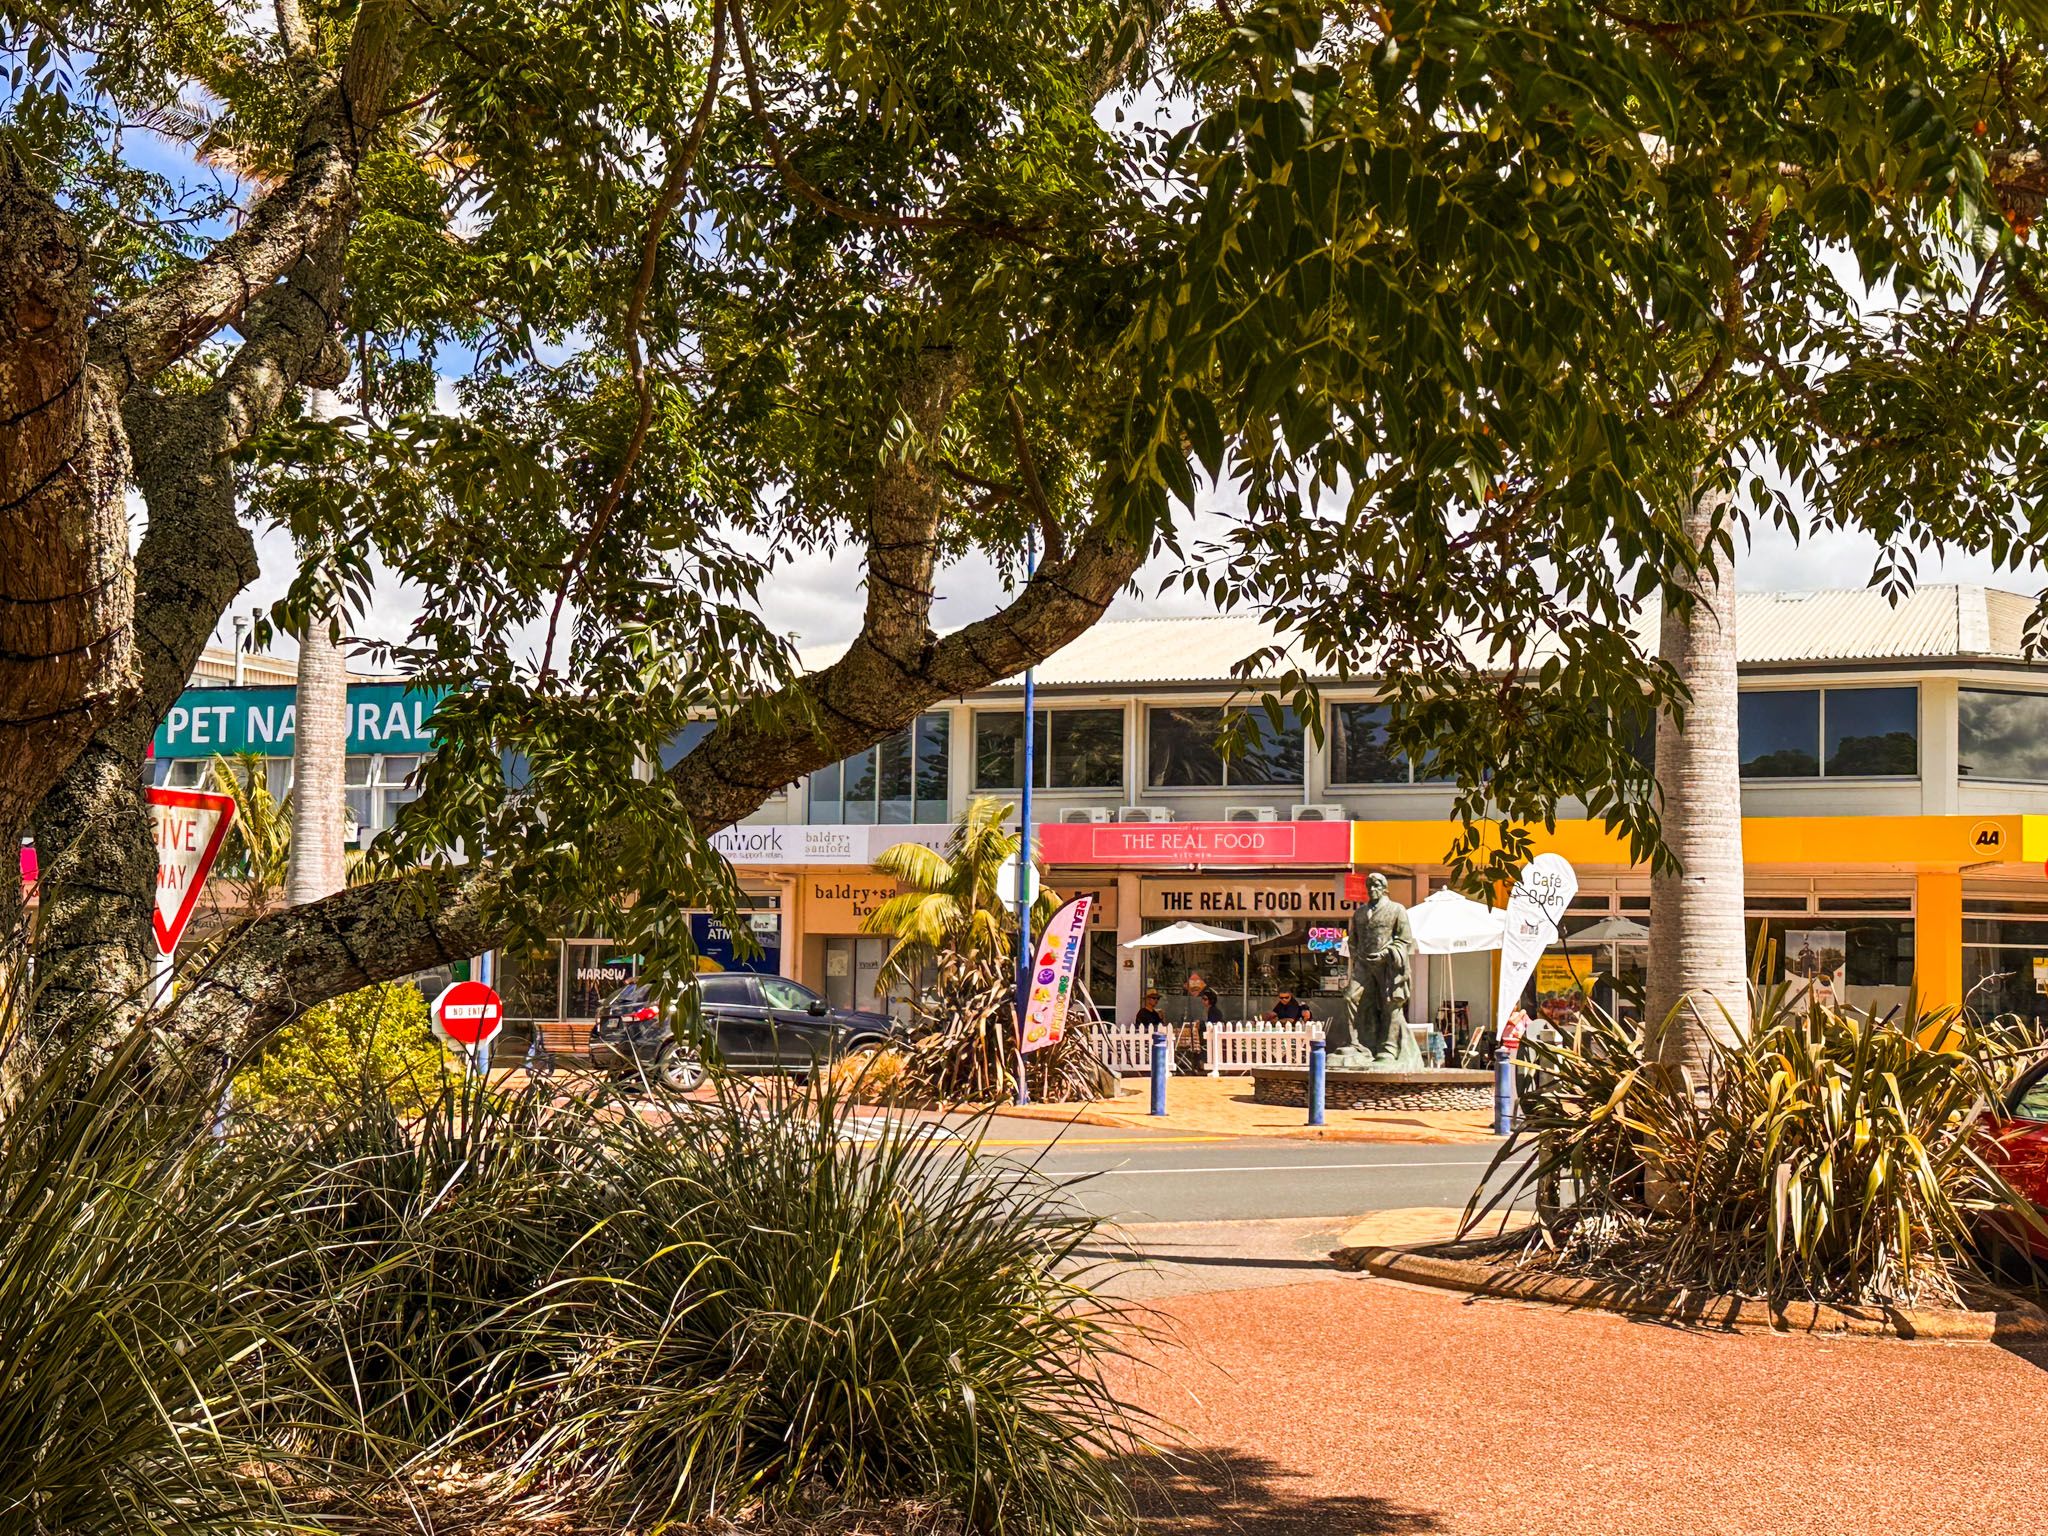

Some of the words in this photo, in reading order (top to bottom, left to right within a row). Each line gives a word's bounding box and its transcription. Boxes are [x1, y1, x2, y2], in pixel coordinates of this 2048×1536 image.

[166, 705, 236, 744] PET
[1122, 833, 1155, 849] THE
[1161, 833, 1208, 849] REAL
[1214, 833, 1265, 849] FOOD
[1975, 830, 1999, 846] AA
[1532, 872, 1562, 888] Café
[815, 884, 896, 904] baldry+sa
[1161, 891, 1193, 911] THE
[1200, 891, 1247, 911] REAL
[1254, 891, 1302, 911] FOOD
[1528, 889, 1564, 908] Open
[853, 902, 879, 916] ho
[1071, 900, 1088, 932] REAL
[707, 918, 726, 929] Sm
[707, 928, 733, 940] ATM
[1308, 927, 1343, 939] OPEN
[1061, 935, 1079, 973] FRUIT
[577, 967, 627, 980] MARROW
[453, 1007, 464, 1016] NO
